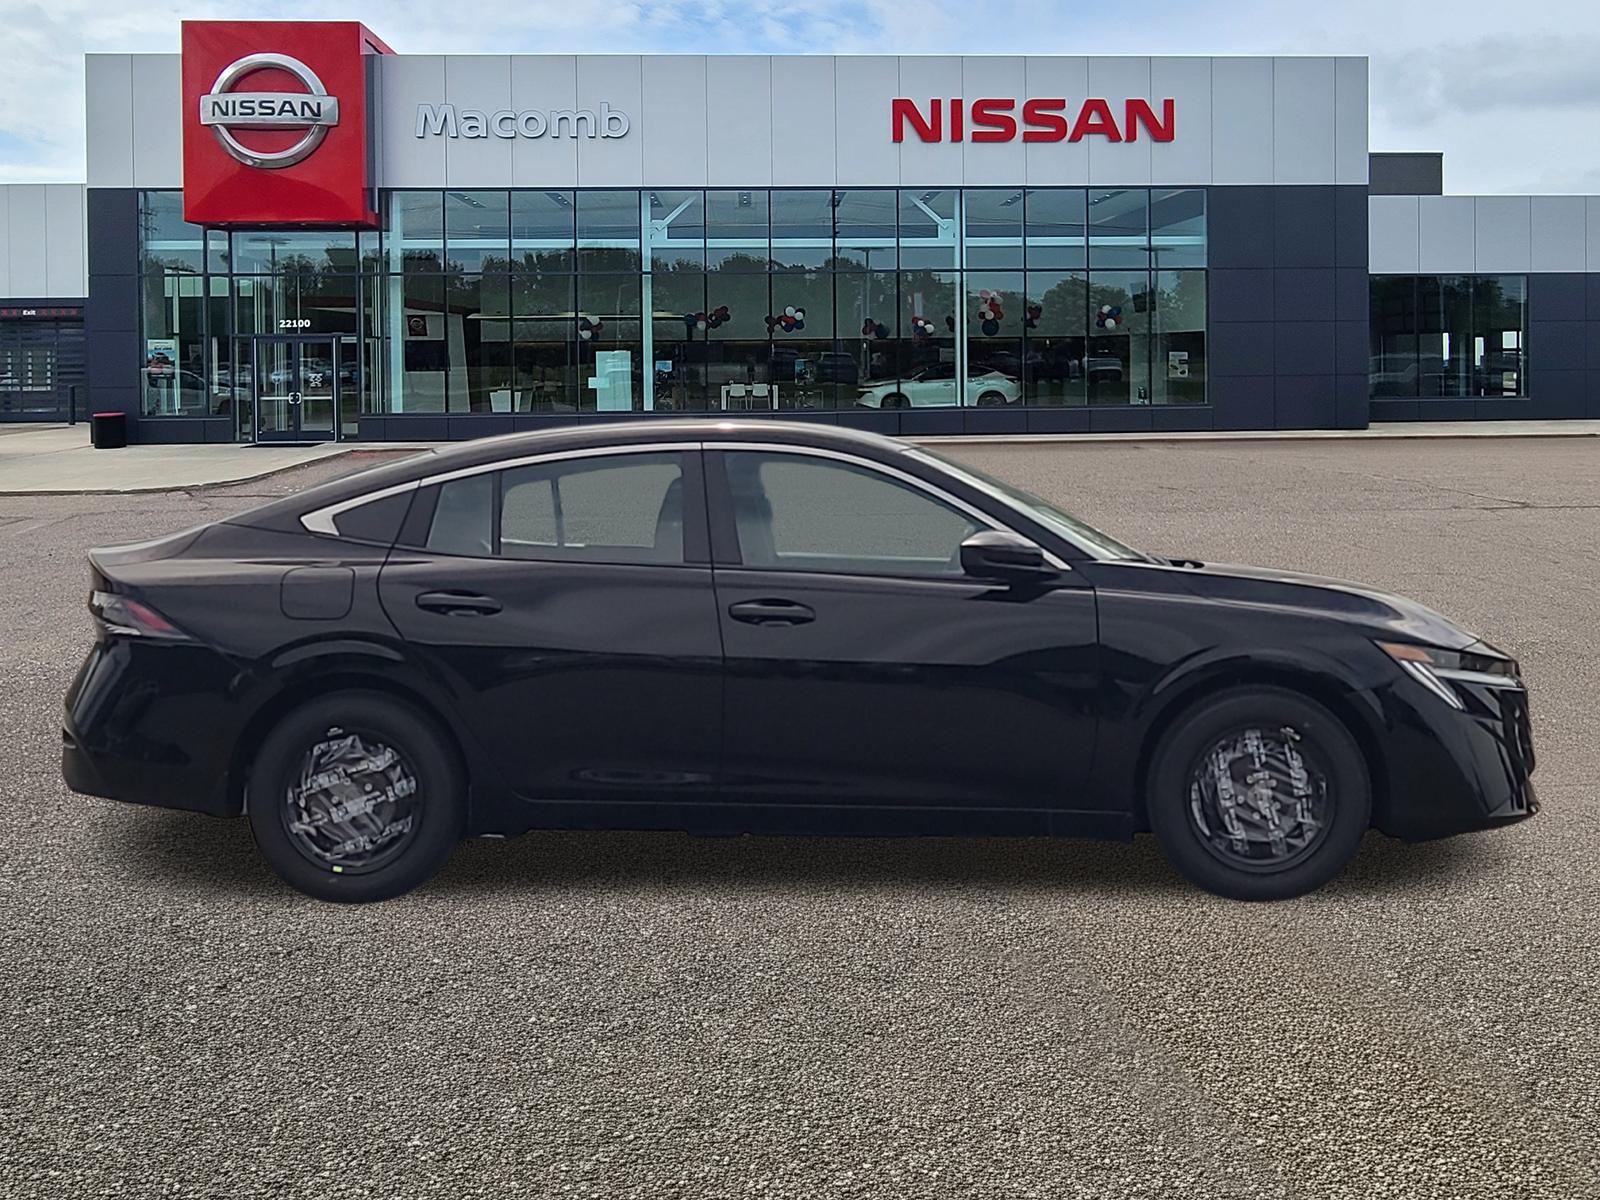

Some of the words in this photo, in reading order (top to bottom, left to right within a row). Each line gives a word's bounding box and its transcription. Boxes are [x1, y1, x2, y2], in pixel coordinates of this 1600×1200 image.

[212, 100, 322, 118] NISSAN
[416, 102, 630, 139] Macomb
[892, 98, 1175, 143] NISSAN
[279, 319, 312, 329] 22100
